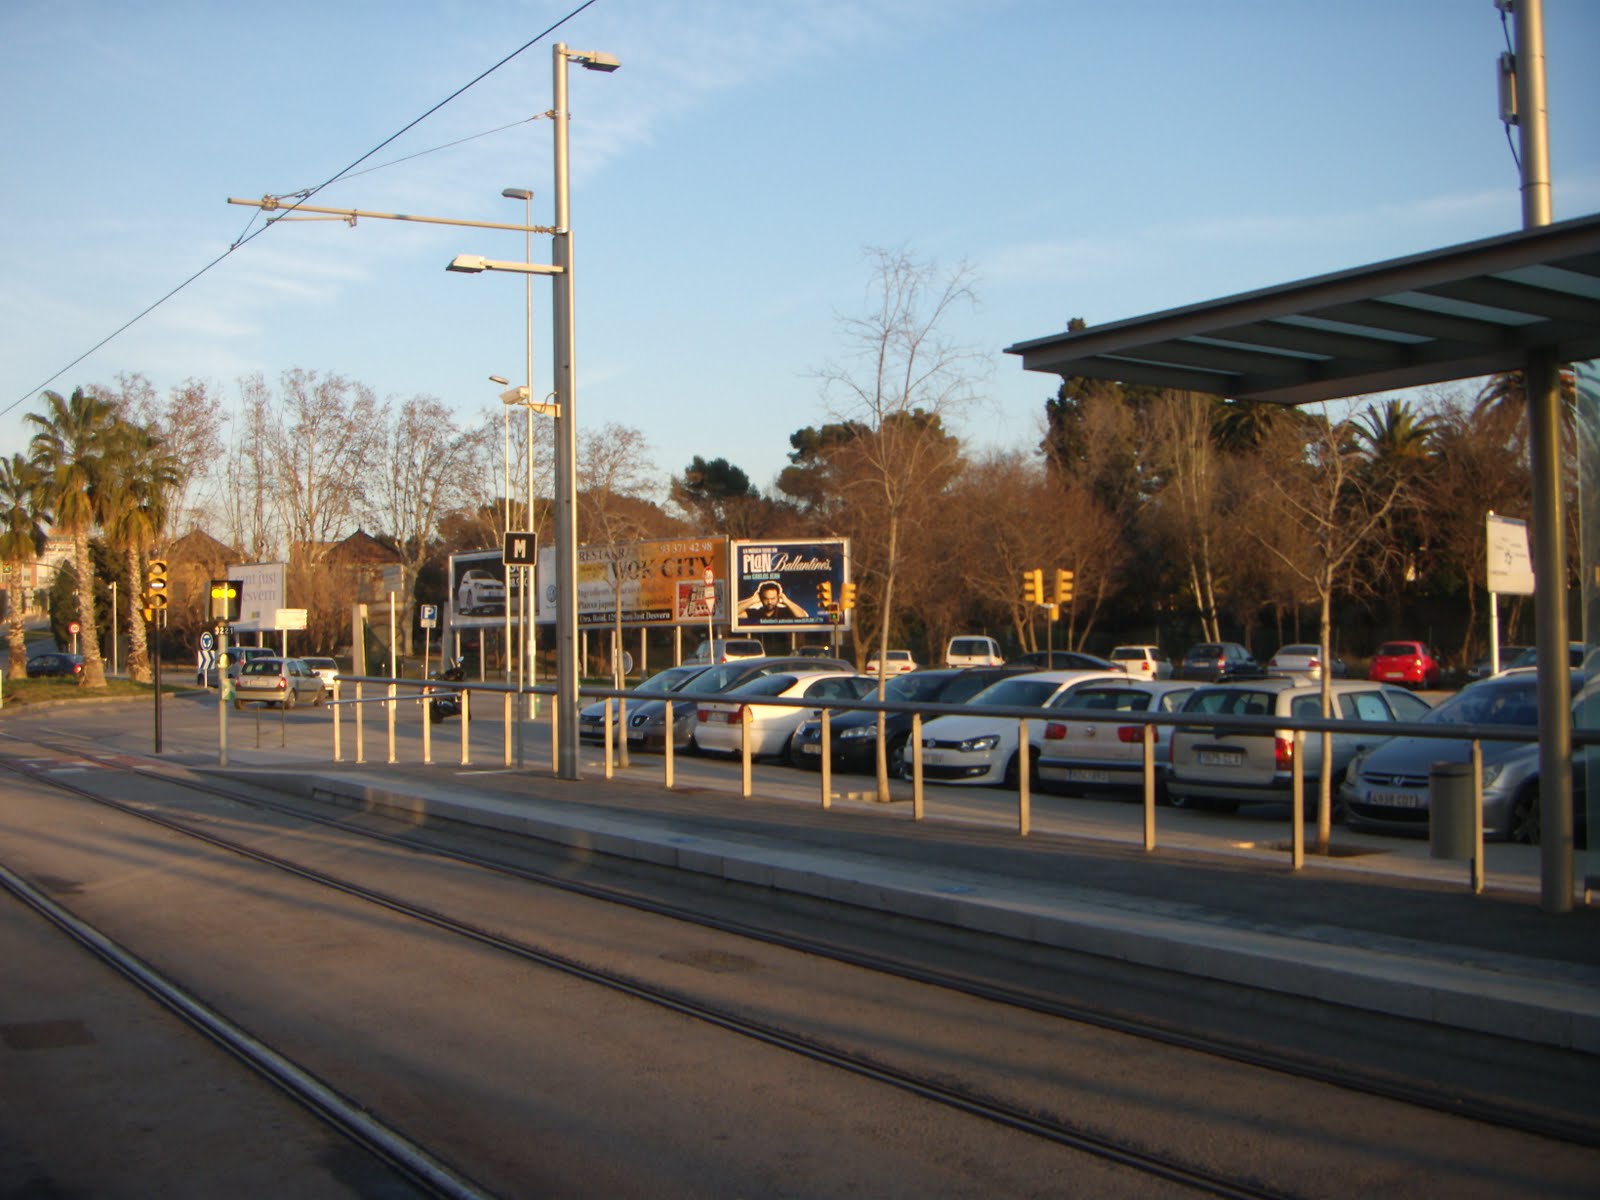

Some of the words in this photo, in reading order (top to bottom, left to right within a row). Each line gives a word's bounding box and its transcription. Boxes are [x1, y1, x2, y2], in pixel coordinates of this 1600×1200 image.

[514, 539, 526, 558] M
[661, 556, 715, 577] CITY
[242, 590, 276, 601] esvern
[424, 607, 434, 619] P
